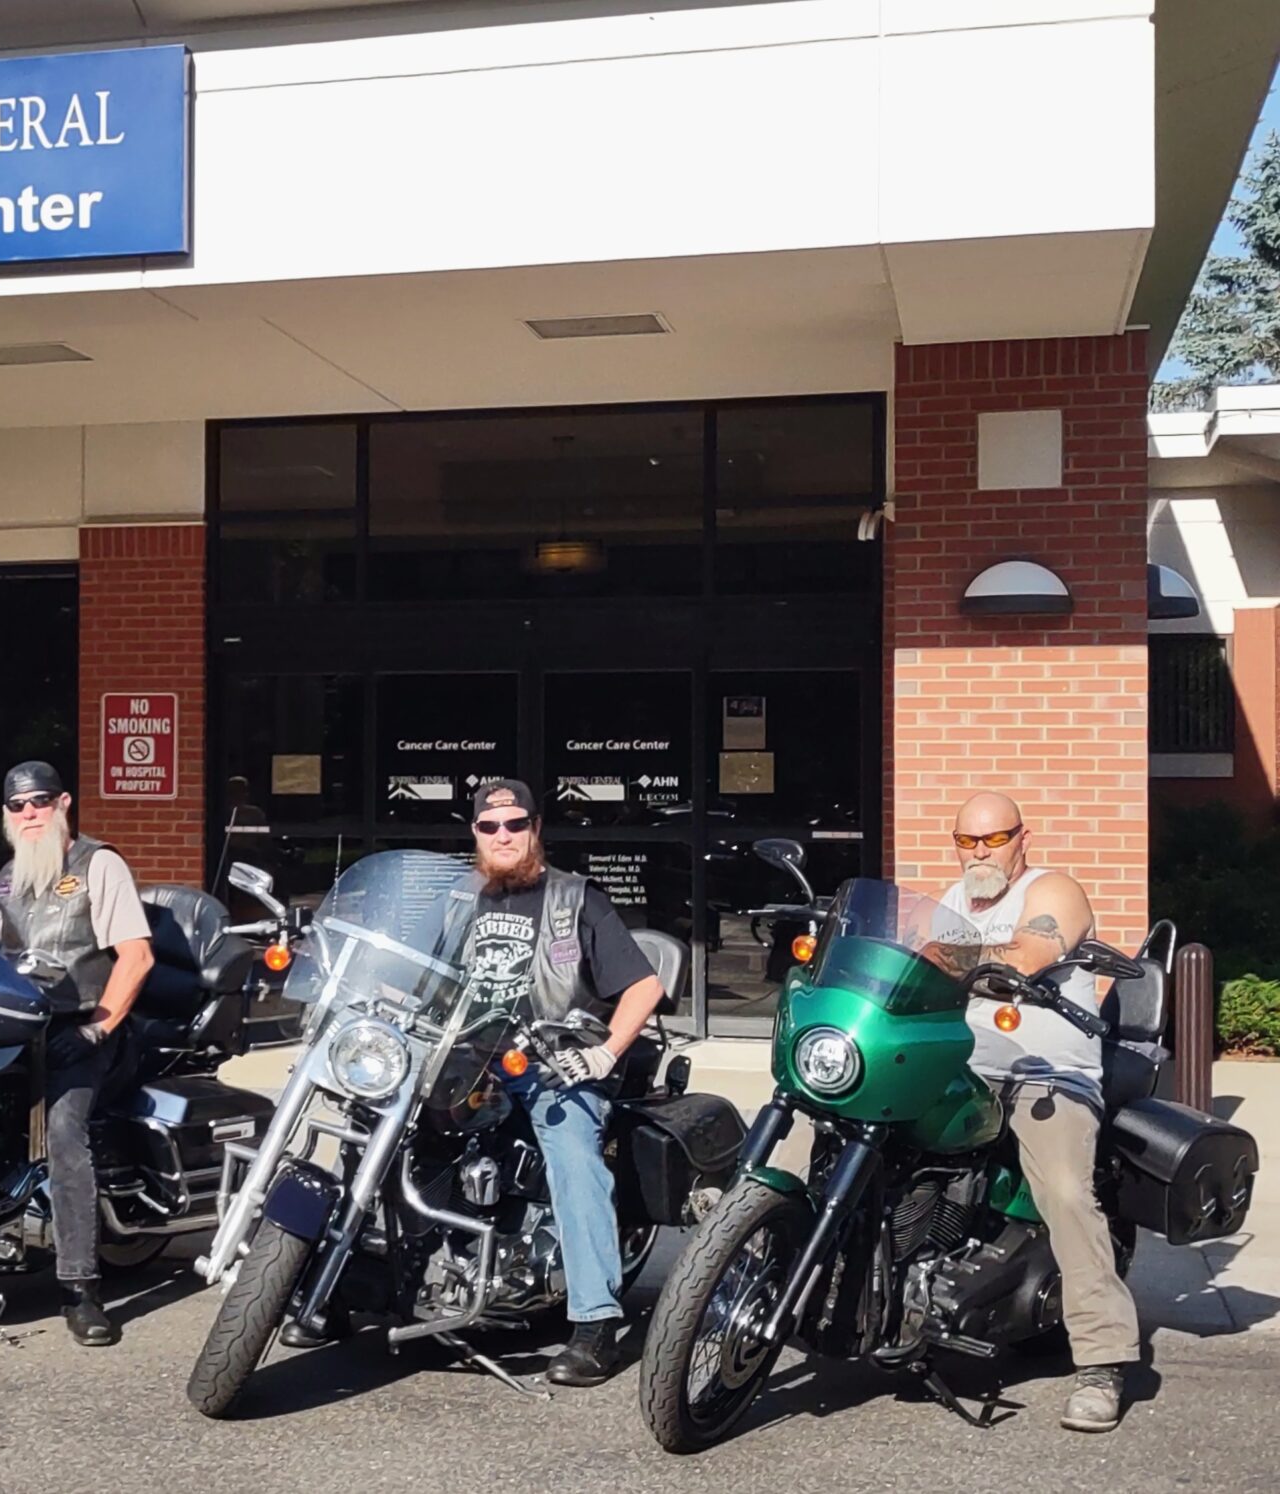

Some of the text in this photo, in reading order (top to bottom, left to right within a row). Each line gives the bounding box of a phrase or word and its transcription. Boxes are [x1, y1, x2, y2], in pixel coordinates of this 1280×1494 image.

[130, 699, 150, 715] NO
[108, 718, 171, 734] SMOKING
[397, 740, 497, 750] Cancer Care Center
[566, 739, 670, 750] Cancer Care Center
[110, 766, 166, 778] ON HOSPITAL
[115, 780, 162, 791] PROPERTY
[652, 776, 679, 787] AHN
[475, 919, 535, 941] UBBED
